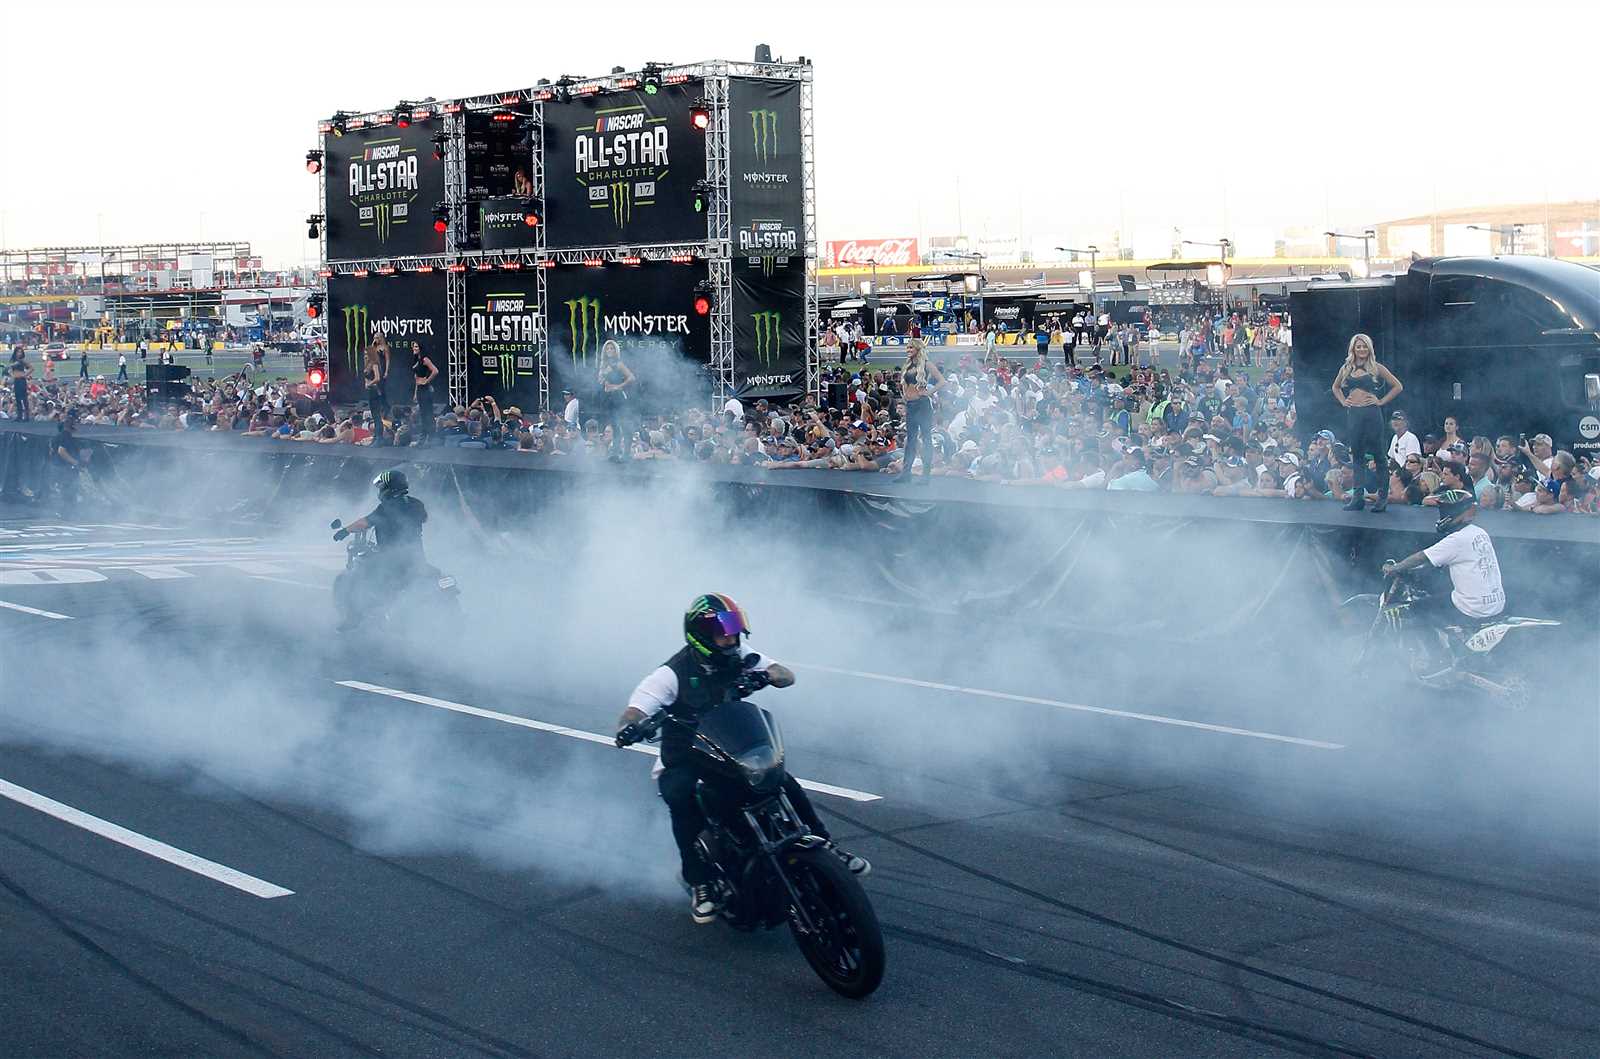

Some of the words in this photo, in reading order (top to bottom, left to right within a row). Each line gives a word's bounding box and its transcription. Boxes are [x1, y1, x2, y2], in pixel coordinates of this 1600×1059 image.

[607, 113, 644, 132] NASCAR
[372, 145, 400, 160] NASCAR
[575, 125, 669, 173] ALL-STAR
[349, 155, 418, 196] ALL-STAR
[588, 167, 655, 180] CHARLOTTE
[743, 172, 789, 183] MONSTER
[359, 191, 408, 202] CHARLOTTE
[591, 188, 606, 198] 20
[638, 184, 652, 195] 17
[484, 212, 525, 223] MONSTER
[759, 223, 782, 231] NASCAR
[739, 230, 797, 250] ALL-STAR
[495, 299, 524, 312] NASCAR
[370, 315, 434, 338] MONSTER
[471, 312, 542, 345] ALL-STAR
[603, 311, 691, 336] MONSTER
[481, 344, 533, 352] CHARLOTTE
[746, 373, 793, 386] MONSTER
